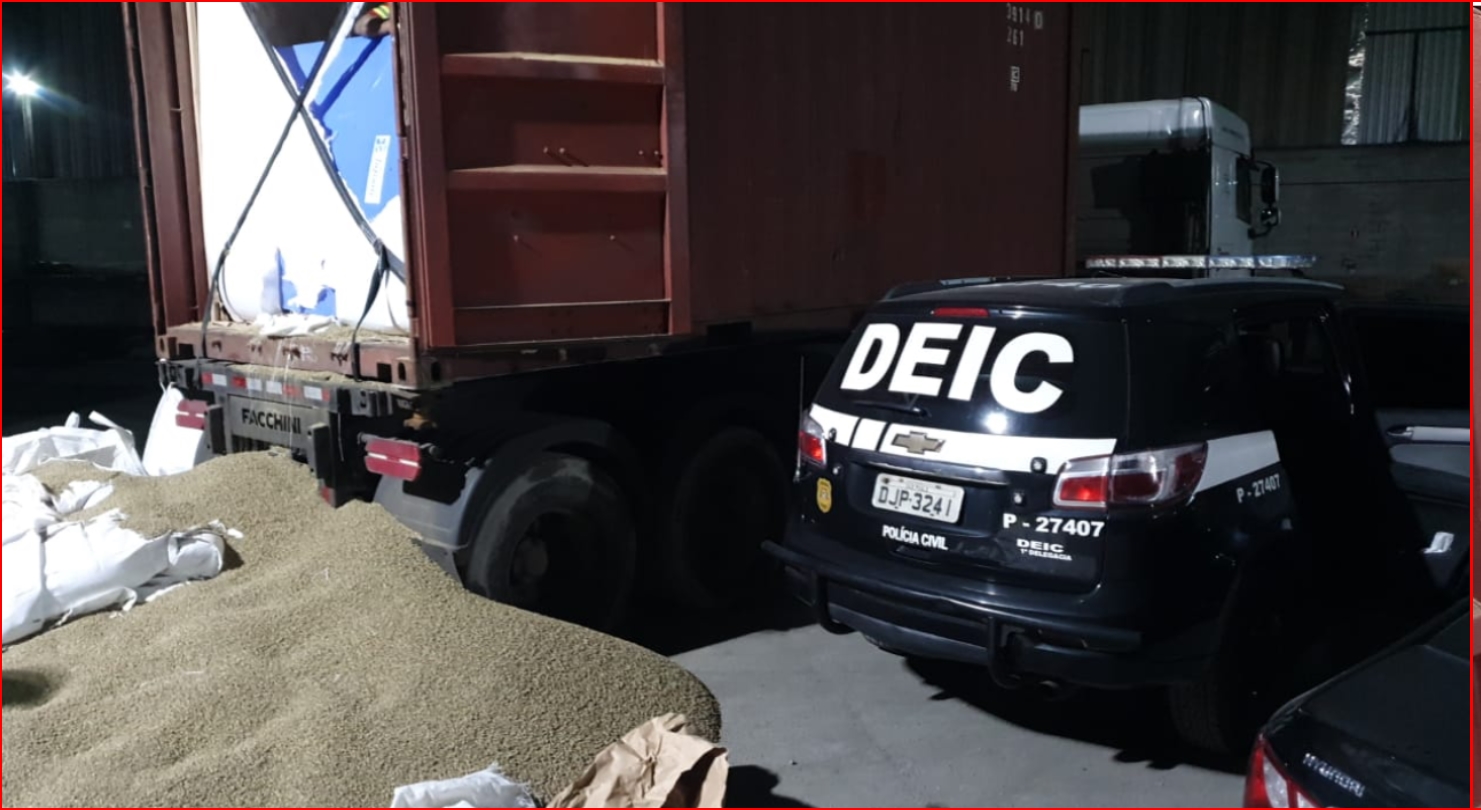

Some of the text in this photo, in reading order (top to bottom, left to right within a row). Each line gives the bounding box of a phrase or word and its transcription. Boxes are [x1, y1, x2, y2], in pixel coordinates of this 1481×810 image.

[840, 322, 1074, 414] DEIC
[242, 408, 302, 434] FACCHINI
[1237, 487, 1244, 503] P
[1254, 474, 1281, 497] 27407
[882, 525, 949, 550] POLÍCIA CIVIL
[1003, 513, 1017, 528] P
[1035, 517, 1105, 537] 27407
[1016, 539, 1064, 553] DEIC
